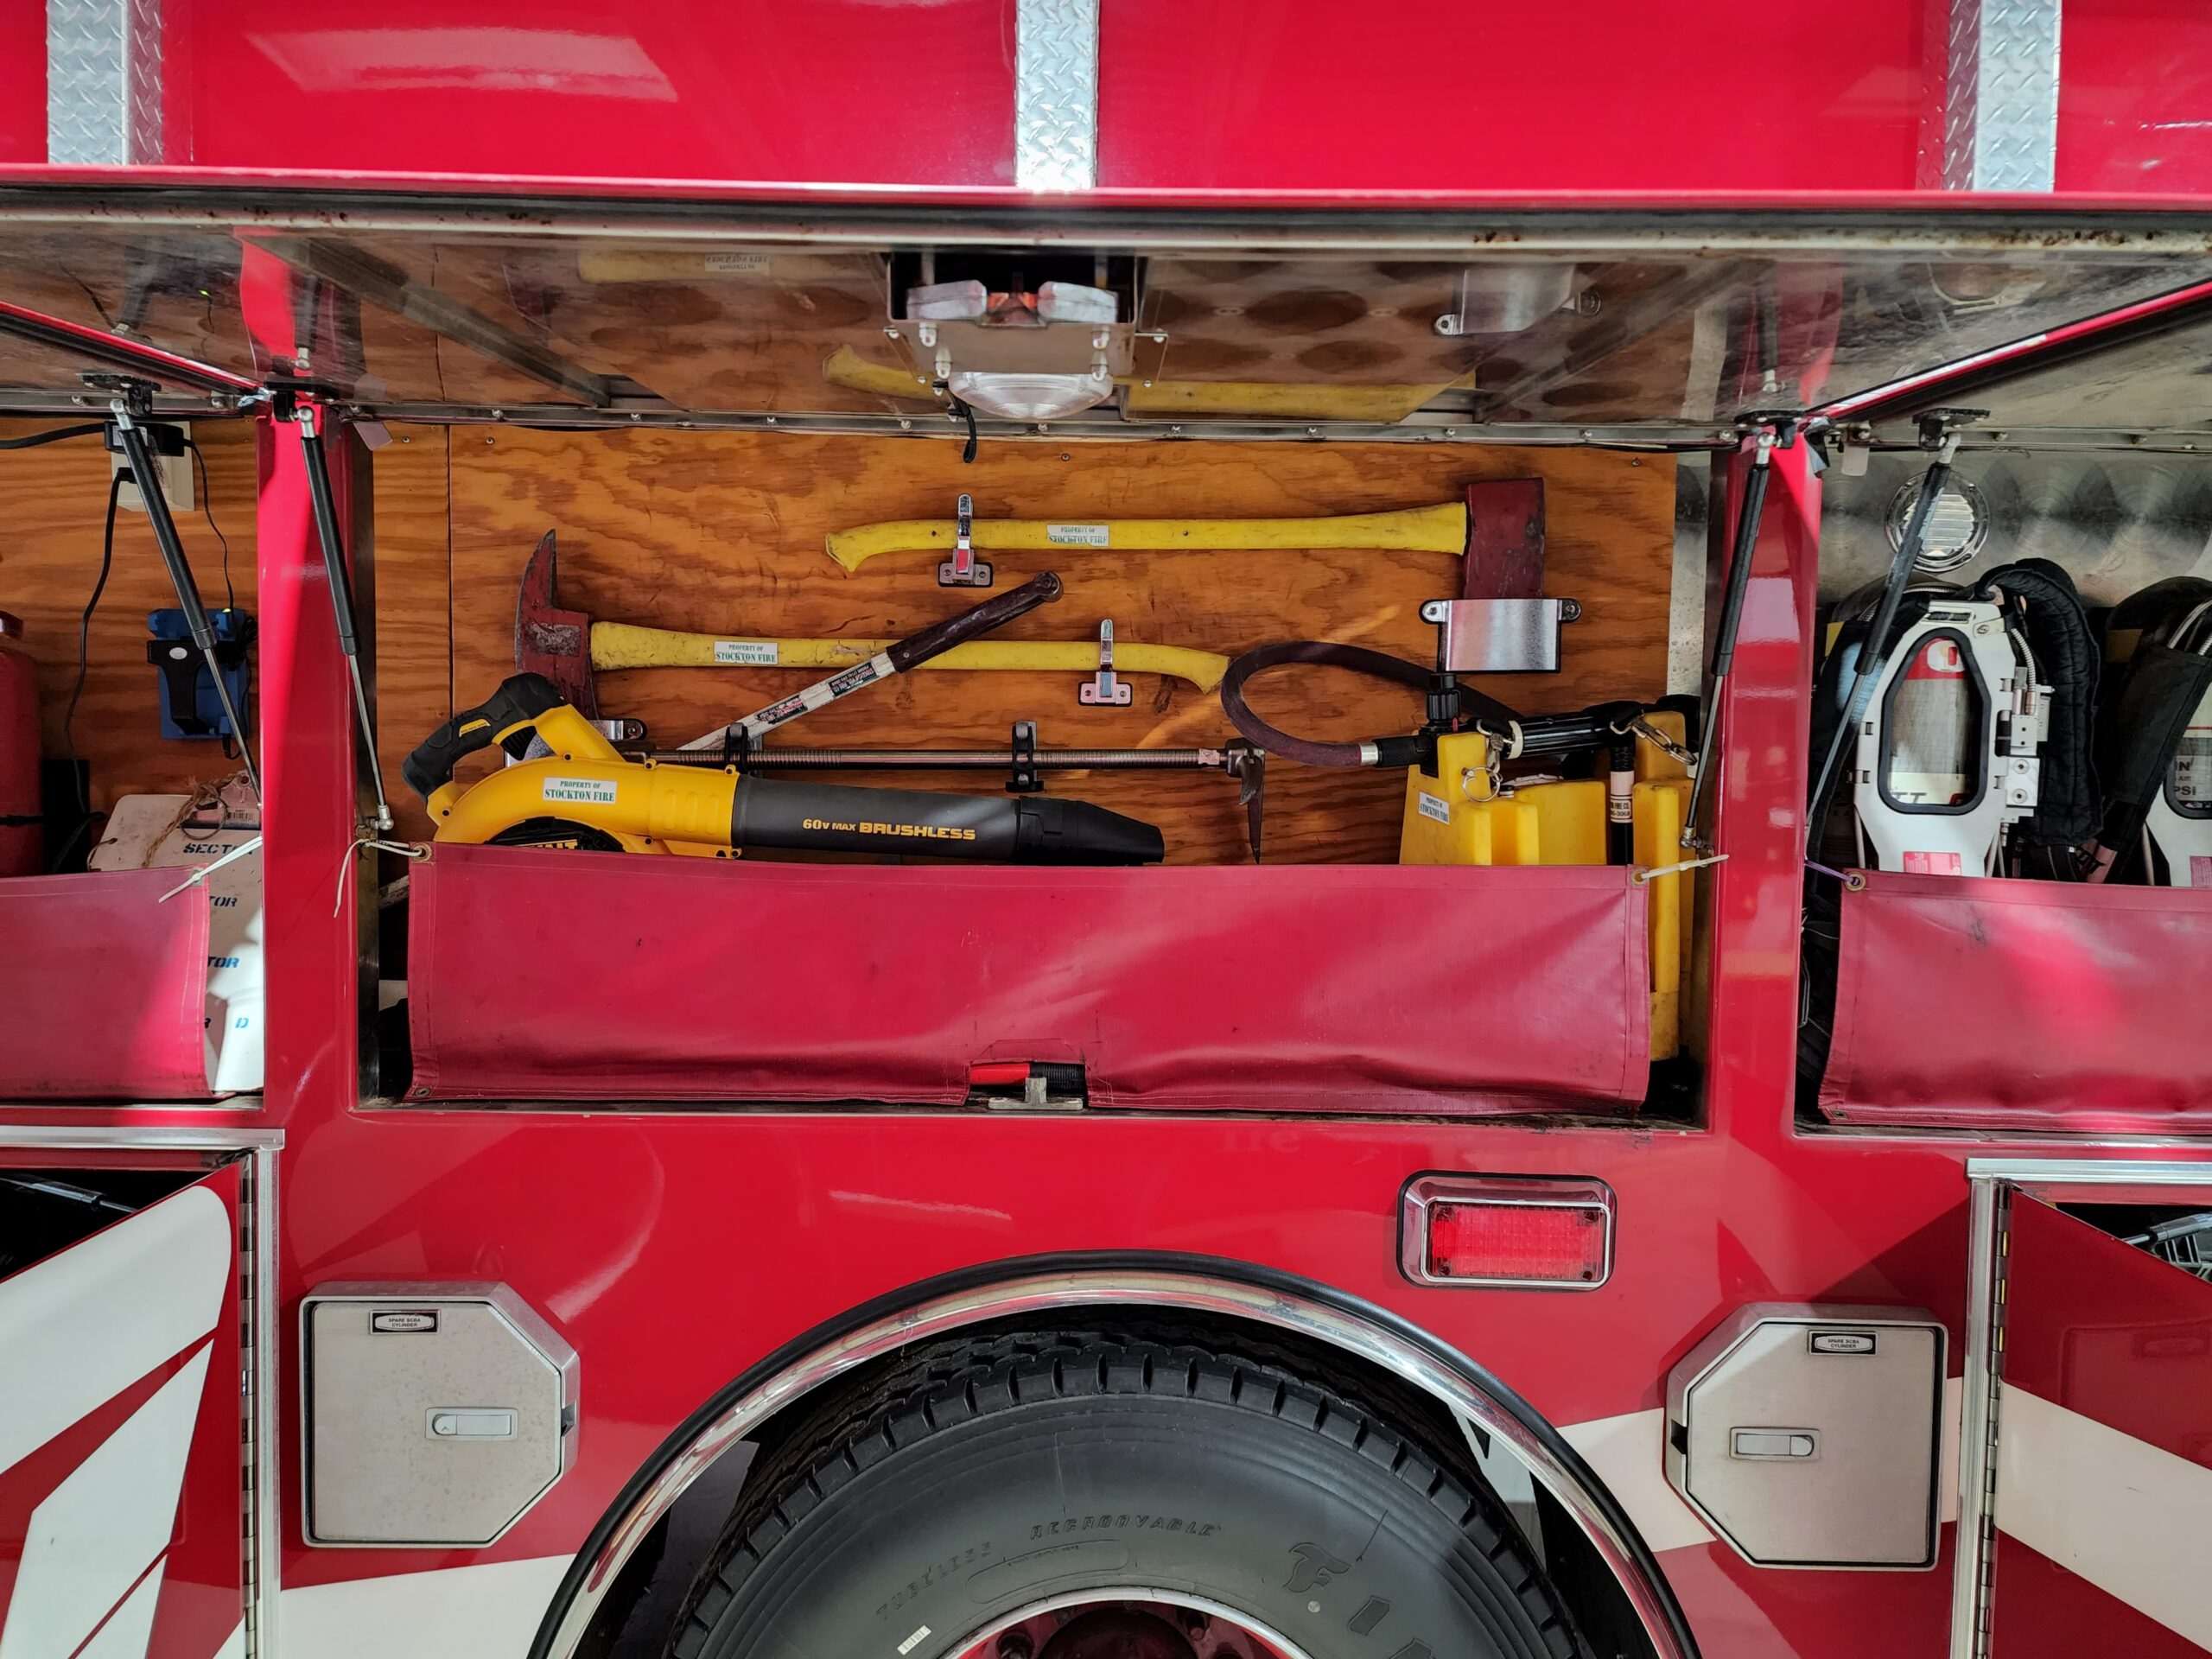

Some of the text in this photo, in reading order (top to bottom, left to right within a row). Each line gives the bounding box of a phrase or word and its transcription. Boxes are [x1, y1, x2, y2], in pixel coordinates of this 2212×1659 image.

[715, 651, 776, 663] STOCKTON FIRE
[544, 788, 614, 802] STOCKTON FIRE
[831, 823, 856, 831] MAX
[859, 822, 976, 841] BRUSHLESS
[1029, 1514, 1214, 1541] REGROOVABLE
